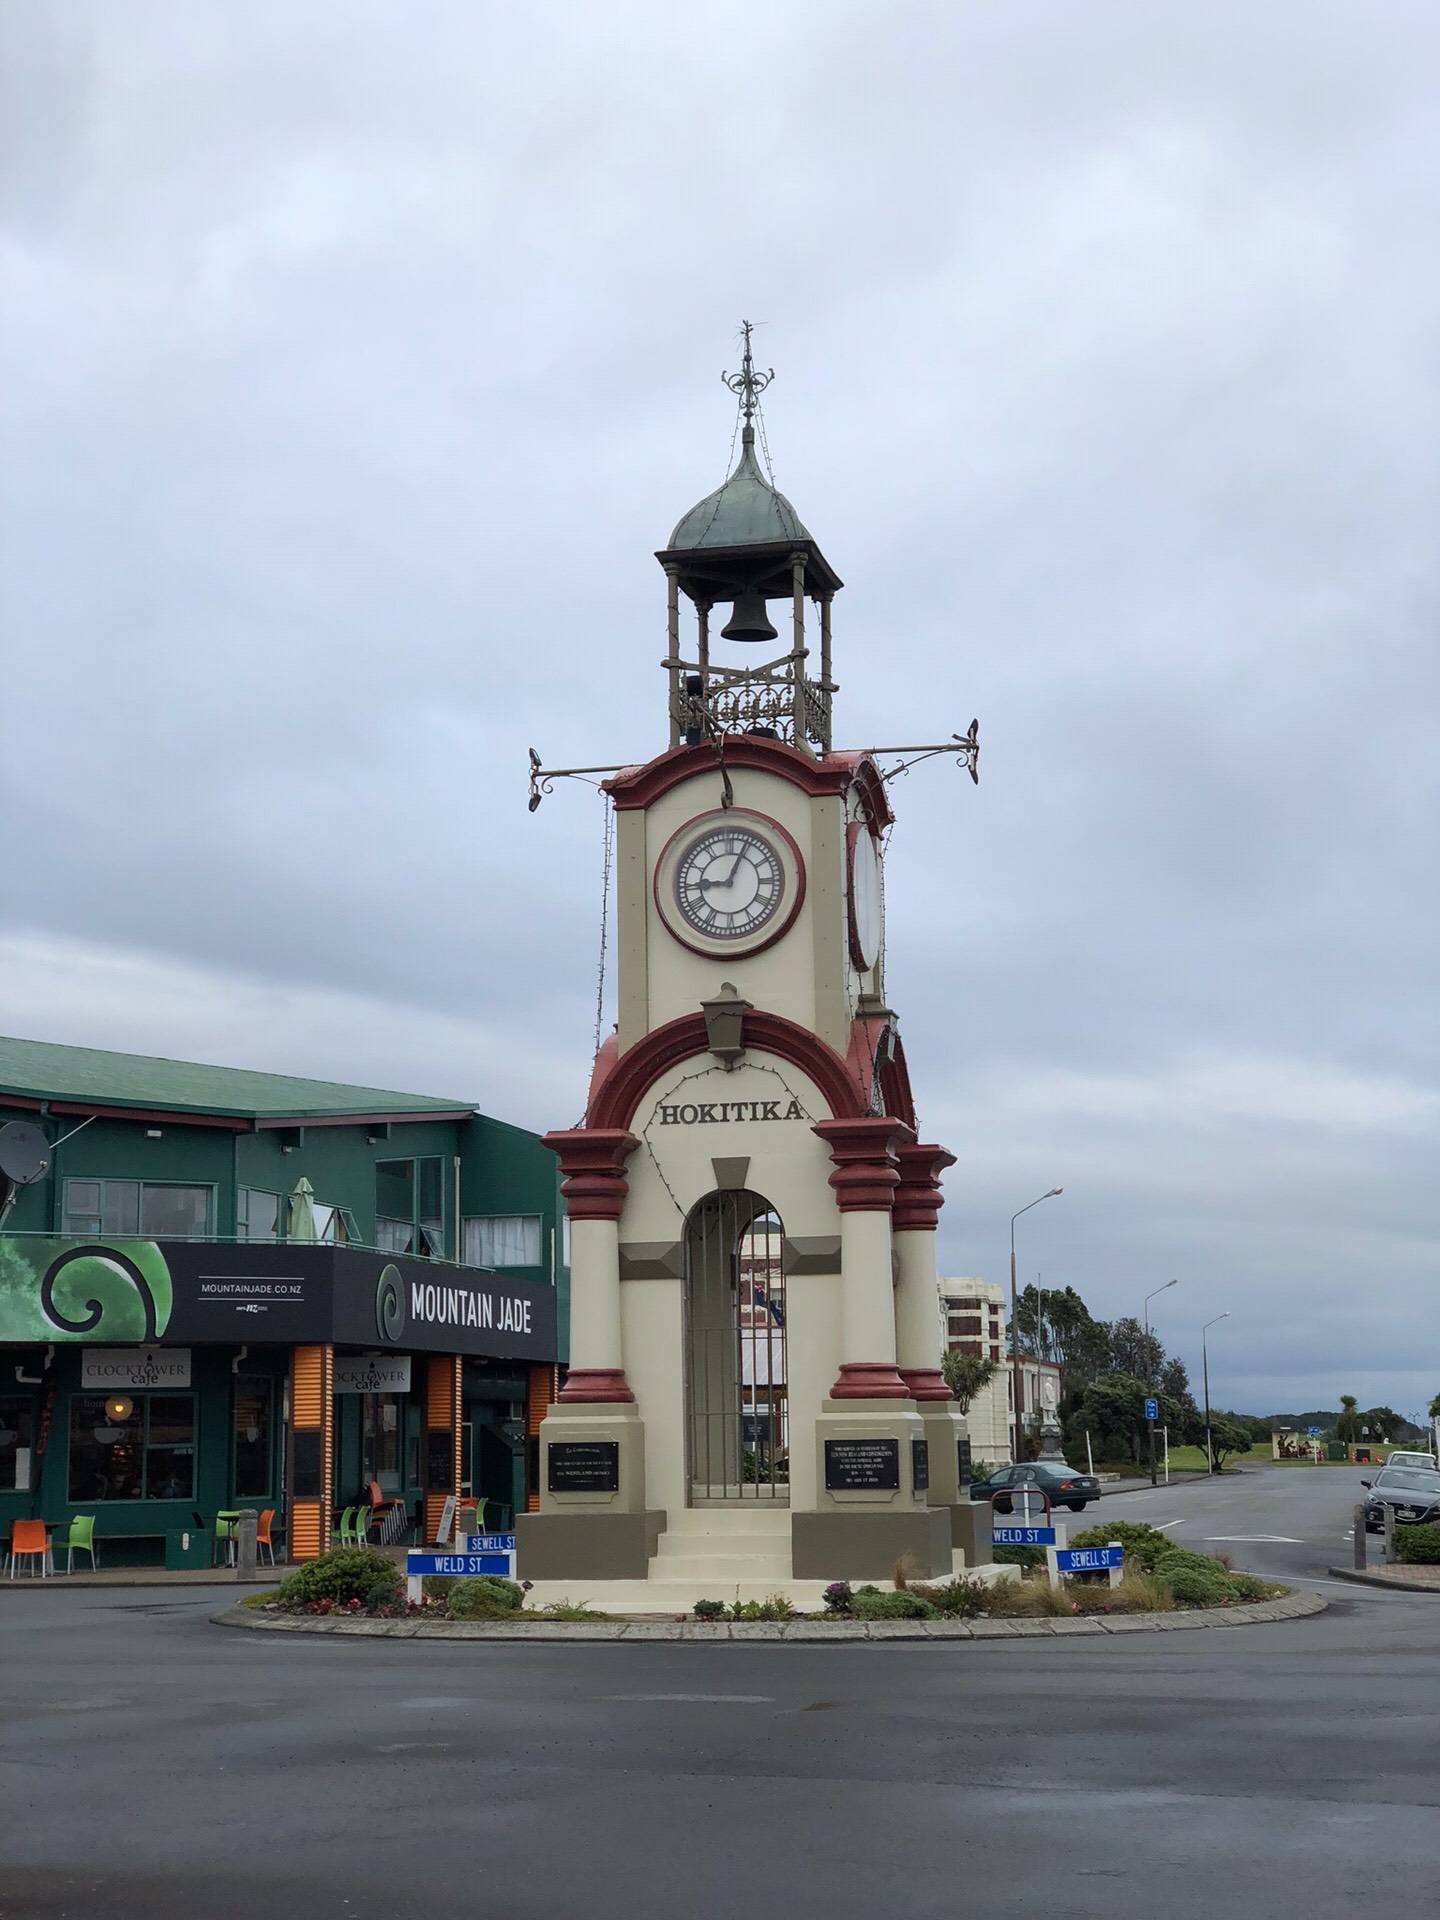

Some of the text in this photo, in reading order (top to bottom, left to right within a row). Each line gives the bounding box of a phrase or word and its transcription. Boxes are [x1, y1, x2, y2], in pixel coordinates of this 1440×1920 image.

[659, 1100, 804, 1125] HOKITIKA
[201, 1284, 302, 1294] MOUNTAINJADE.CO.NZ
[412, 1282, 531, 1334] MOUNTAIN JADE
[87, 1364, 185, 1377] CLOCKTOWER
[131, 1370, 158, 1385] cafe
[472, 1536, 516, 1550] SEWELL ST
[993, 1529, 1039, 1542] WELD ST
[434, 1557, 482, 1572] WELD ST
[1071, 1550, 1110, 1568] SEWELL ST
